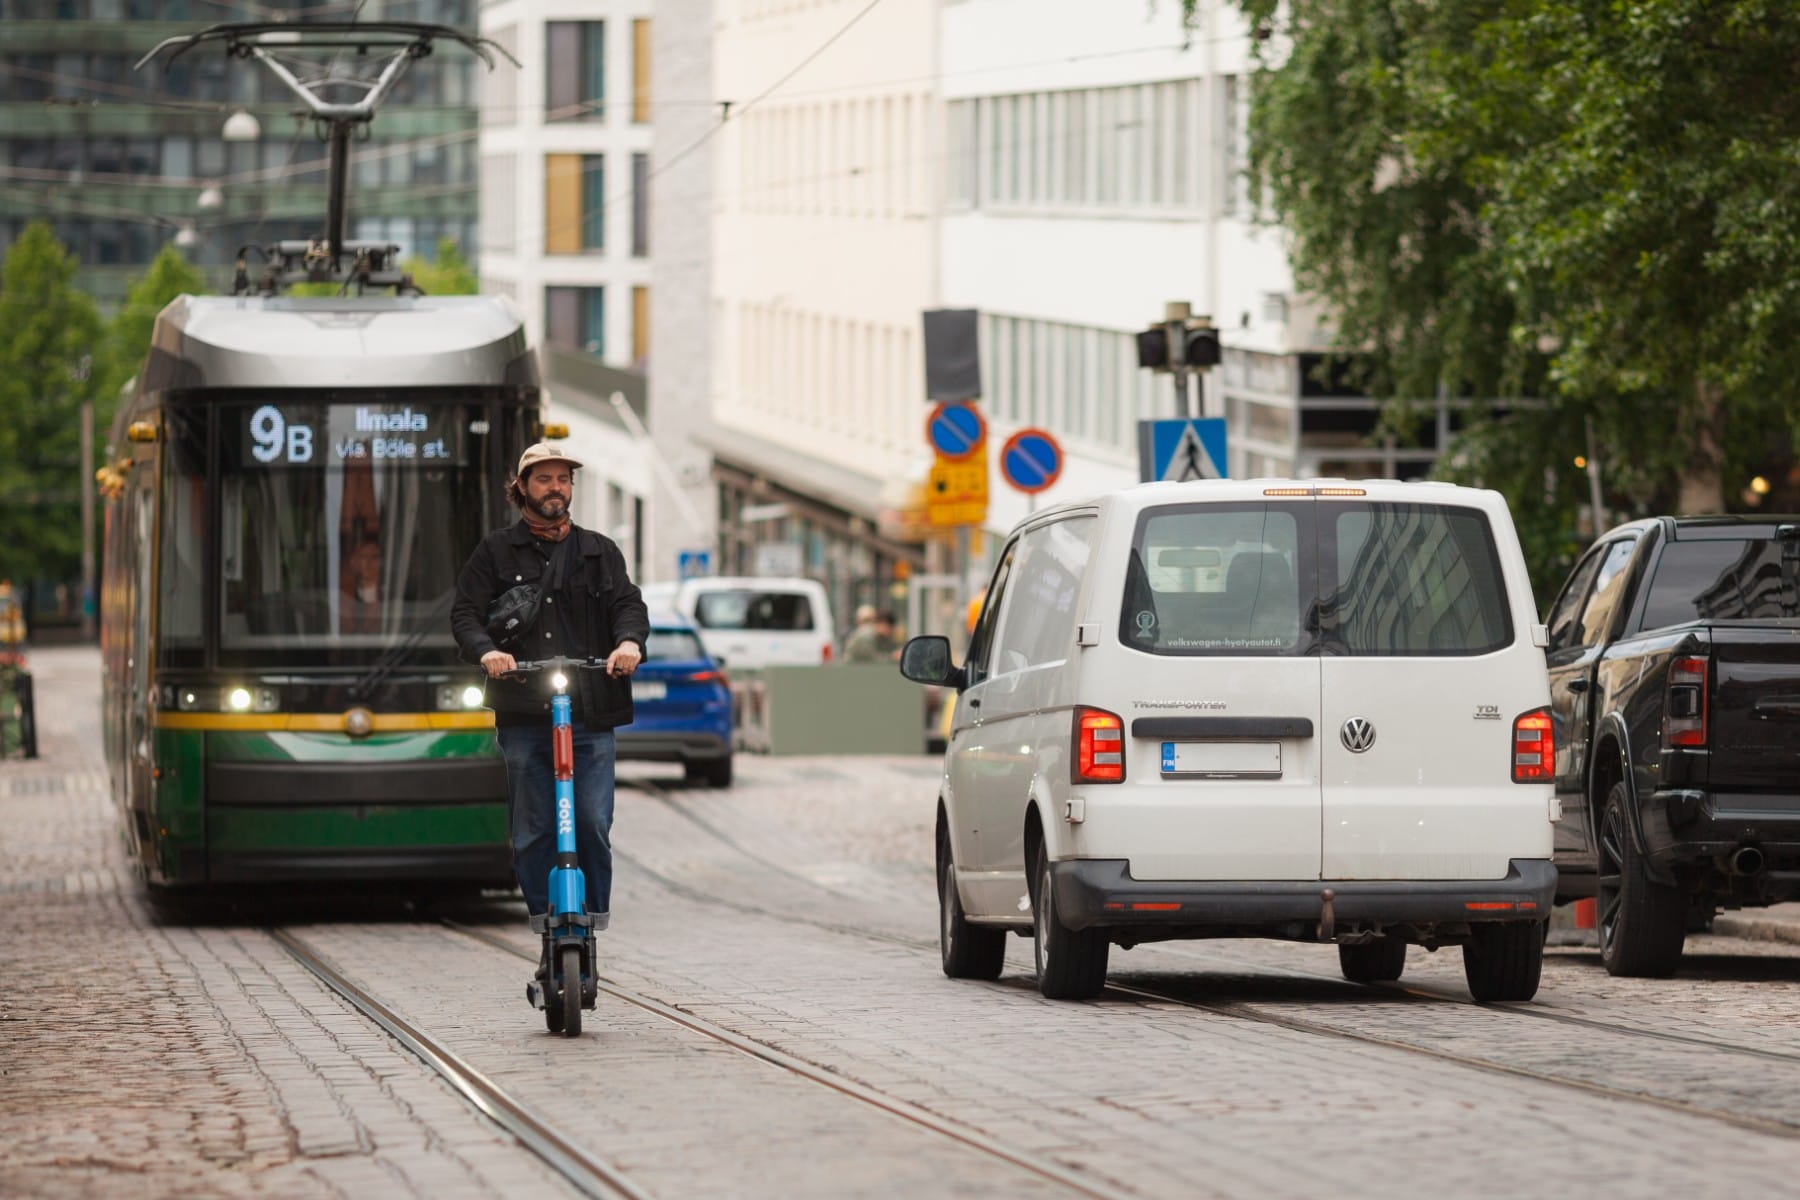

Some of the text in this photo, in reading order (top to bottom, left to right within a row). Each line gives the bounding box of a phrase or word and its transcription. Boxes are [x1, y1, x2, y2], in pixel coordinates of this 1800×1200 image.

[355, 407, 428, 432] Ilmala
[335, 440, 366, 459] via
[372, 438, 416, 458] Böle
[1132, 700, 1227, 710] TRANSPORTER
[1476, 705, 1498, 713] TDI
[1162, 759, 1175, 767] FIN
[558, 798, 572, 834] dott
